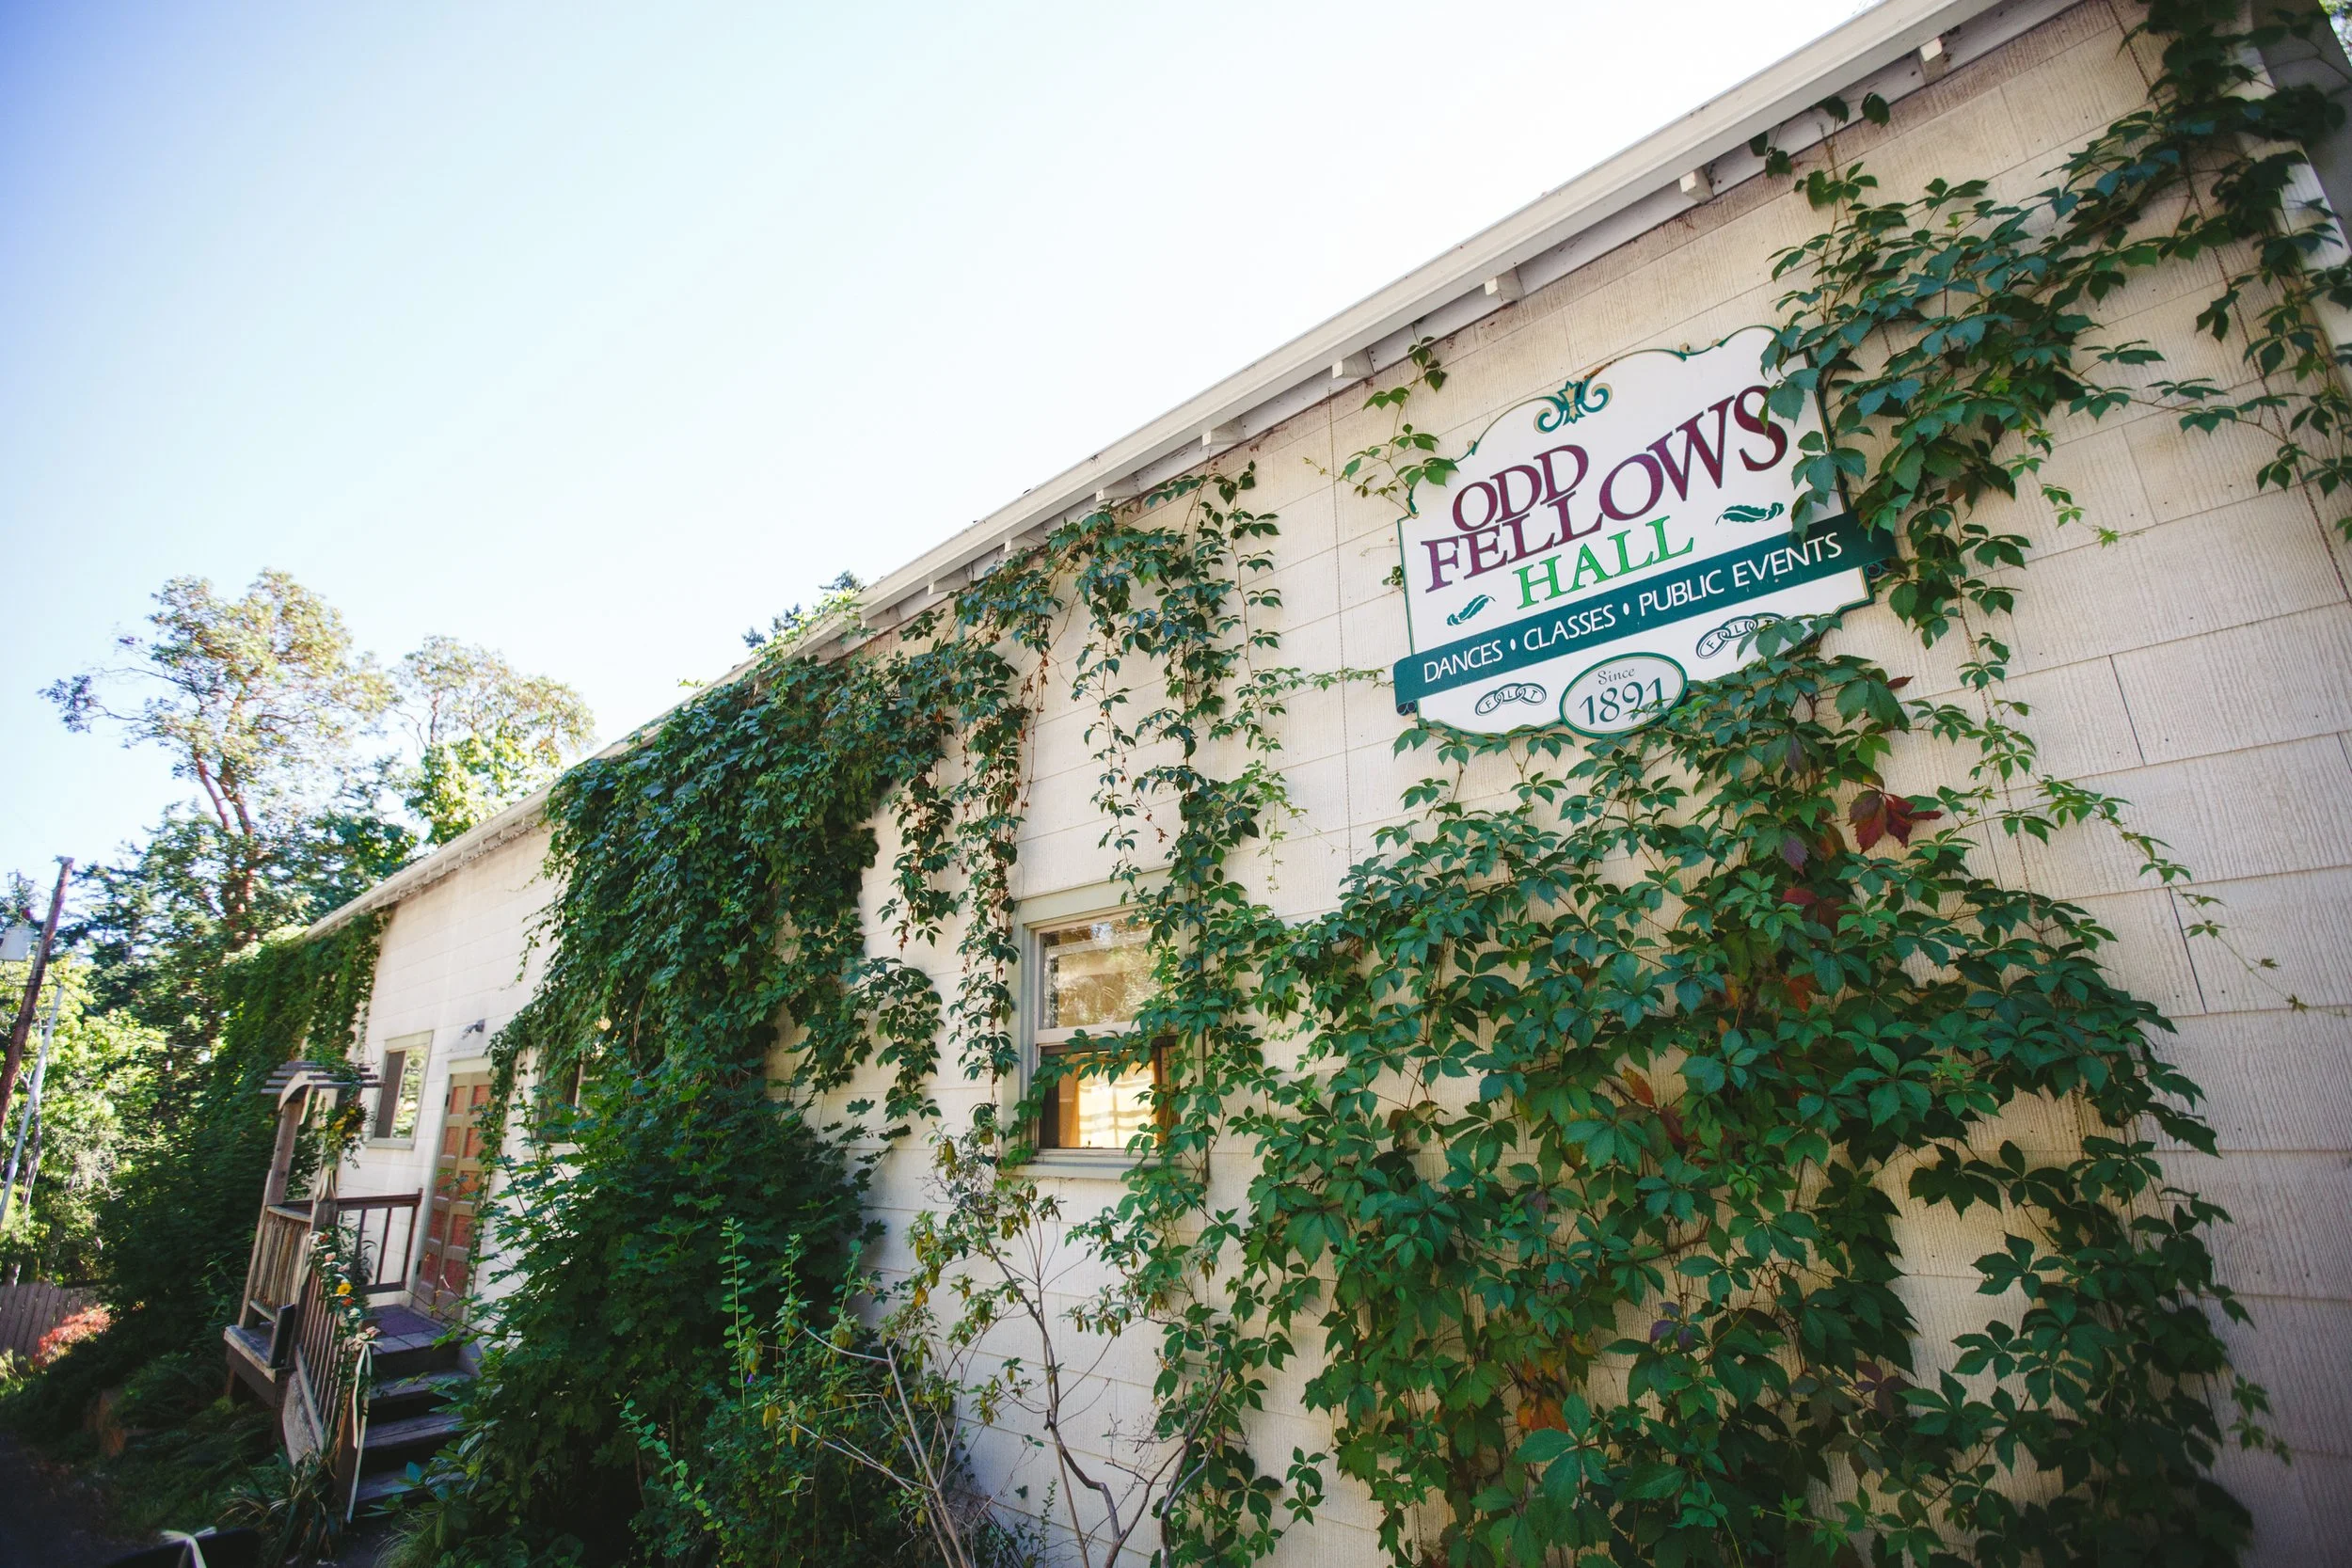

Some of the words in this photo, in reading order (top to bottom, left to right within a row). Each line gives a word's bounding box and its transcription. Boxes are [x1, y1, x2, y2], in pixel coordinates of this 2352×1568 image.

[1420, 386, 1788, 594] FELLOWS
[1452, 444, 1590, 532] ODD
[1423, 639, 1503, 683] DANCES
[1522, 604, 1616, 651] CLASSES
[1639, 565, 1724, 616] PUBLIC
[1732, 531, 1843, 588] EVENTS
[1512, 515, 1694, 610] HALL
[1579, 677, 1664, 725] 1891
[1597, 668, 1635, 686] Since
